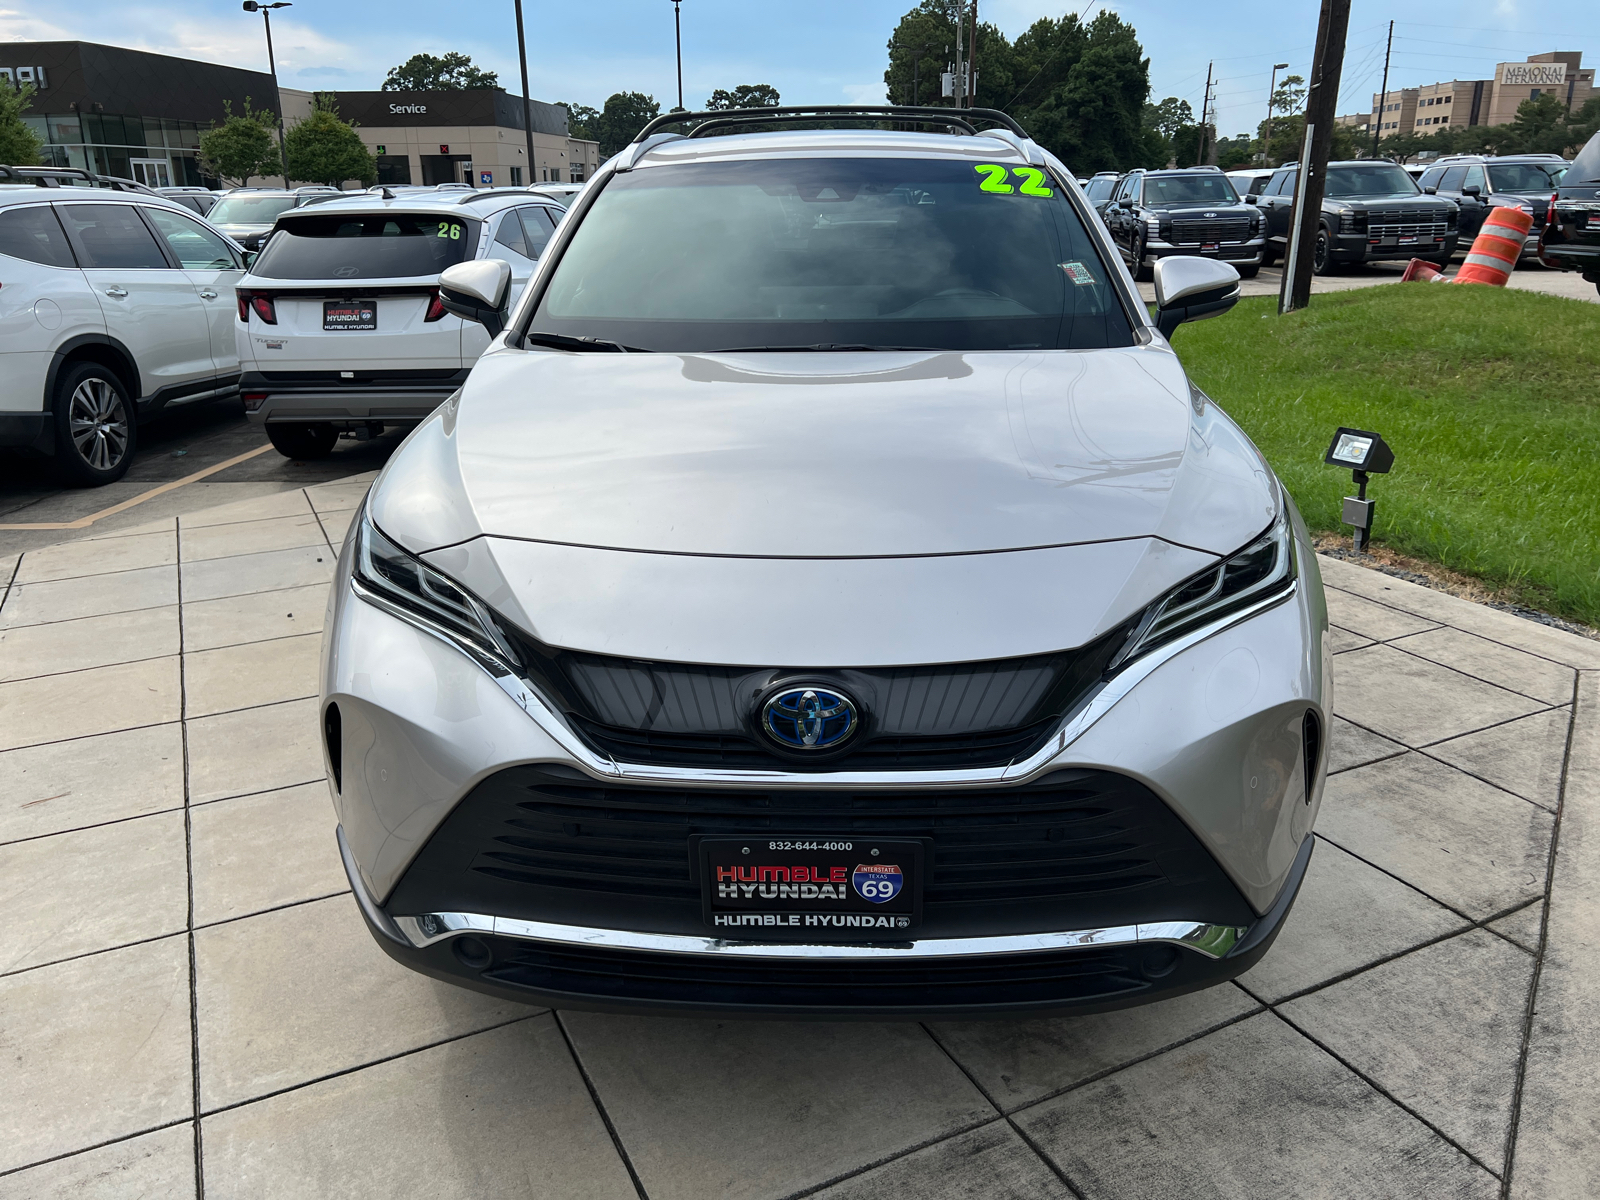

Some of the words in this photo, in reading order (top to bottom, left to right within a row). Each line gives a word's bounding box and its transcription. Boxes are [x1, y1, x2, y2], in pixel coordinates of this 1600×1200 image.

[1506, 66, 1563, 76] MEMORIAL
[1505, 75, 1562, 83] HERMANN
[389, 103, 427, 114] Service
[975, 164, 1053, 198] 22
[437, 221, 460, 240] 26
[769, 841, 853, 851] 832-644-4000
[716, 866, 848, 882] HUMBLE
[718, 883, 847, 899] HYUNDAI
[861, 880, 894, 898] 69
[714, 914, 801, 926] HUMBLE
[805, 915, 895, 928] HYUNDAI
